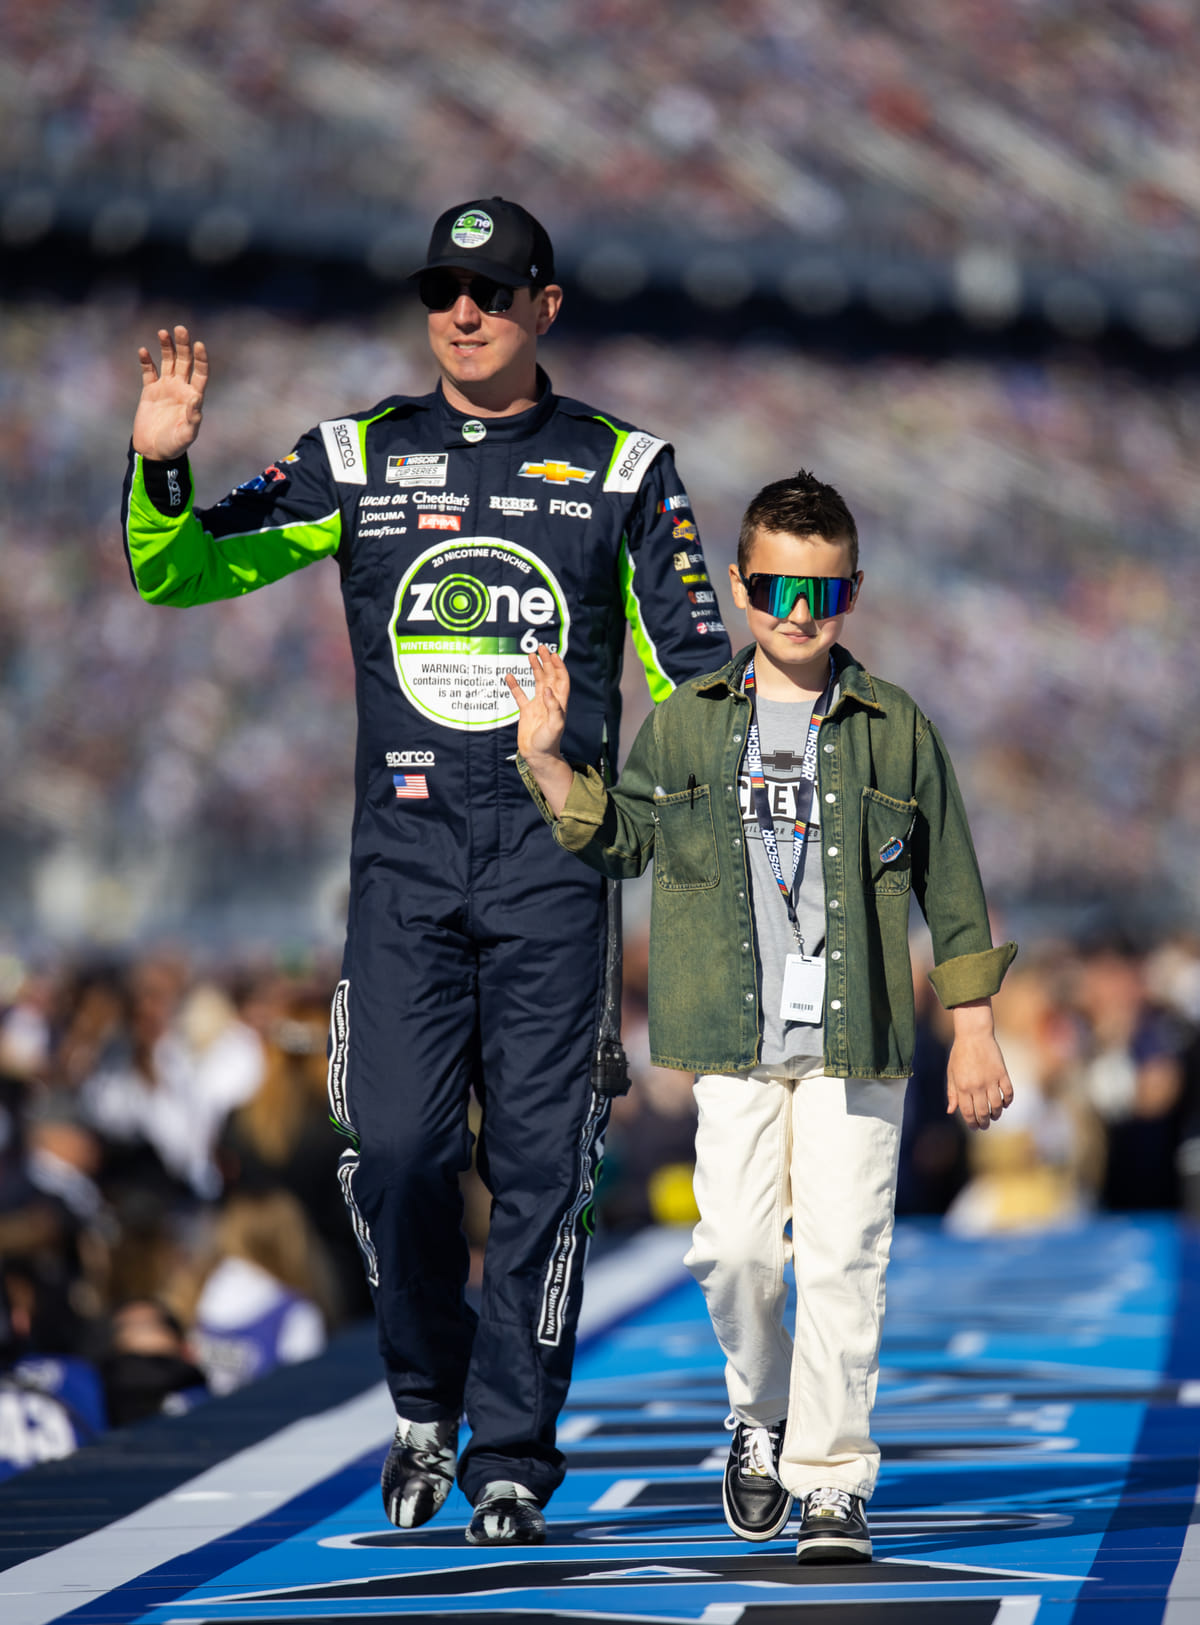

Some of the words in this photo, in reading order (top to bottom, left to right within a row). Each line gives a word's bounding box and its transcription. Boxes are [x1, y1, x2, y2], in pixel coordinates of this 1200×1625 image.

[333, 424, 356, 469] sparco
[618, 437, 654, 480] sparco
[359, 496, 391, 507] LUCAS
[391, 494, 409, 505] OIL
[412, 491, 470, 506] Cheddar's
[489, 496, 538, 511] REBEL
[549, 499, 592, 518] FICO
[366, 511, 406, 521] OKUMA
[432, 556, 444, 568] 20
[444, 548, 489, 562] NICOTINE
[490, 549, 533, 574] POUCHES
[407, 573, 555, 632] zone
[421, 663, 469, 674] WARNING:
[472, 664, 493, 675] This
[496, 665, 533, 676] product
[412, 676, 451, 686] contains
[438, 688, 447, 697] is
[449, 690, 462, 698] an
[385, 750, 435, 767] sparco
[801, 729, 818, 781] NASCAR
[762, 829, 783, 880] NASCAR
[335, 989, 346, 1041] WARNING:
[332, 1063, 342, 1100] product
[545, 1285, 561, 1335] WARNING:
[554, 1263, 563, 1284] This
